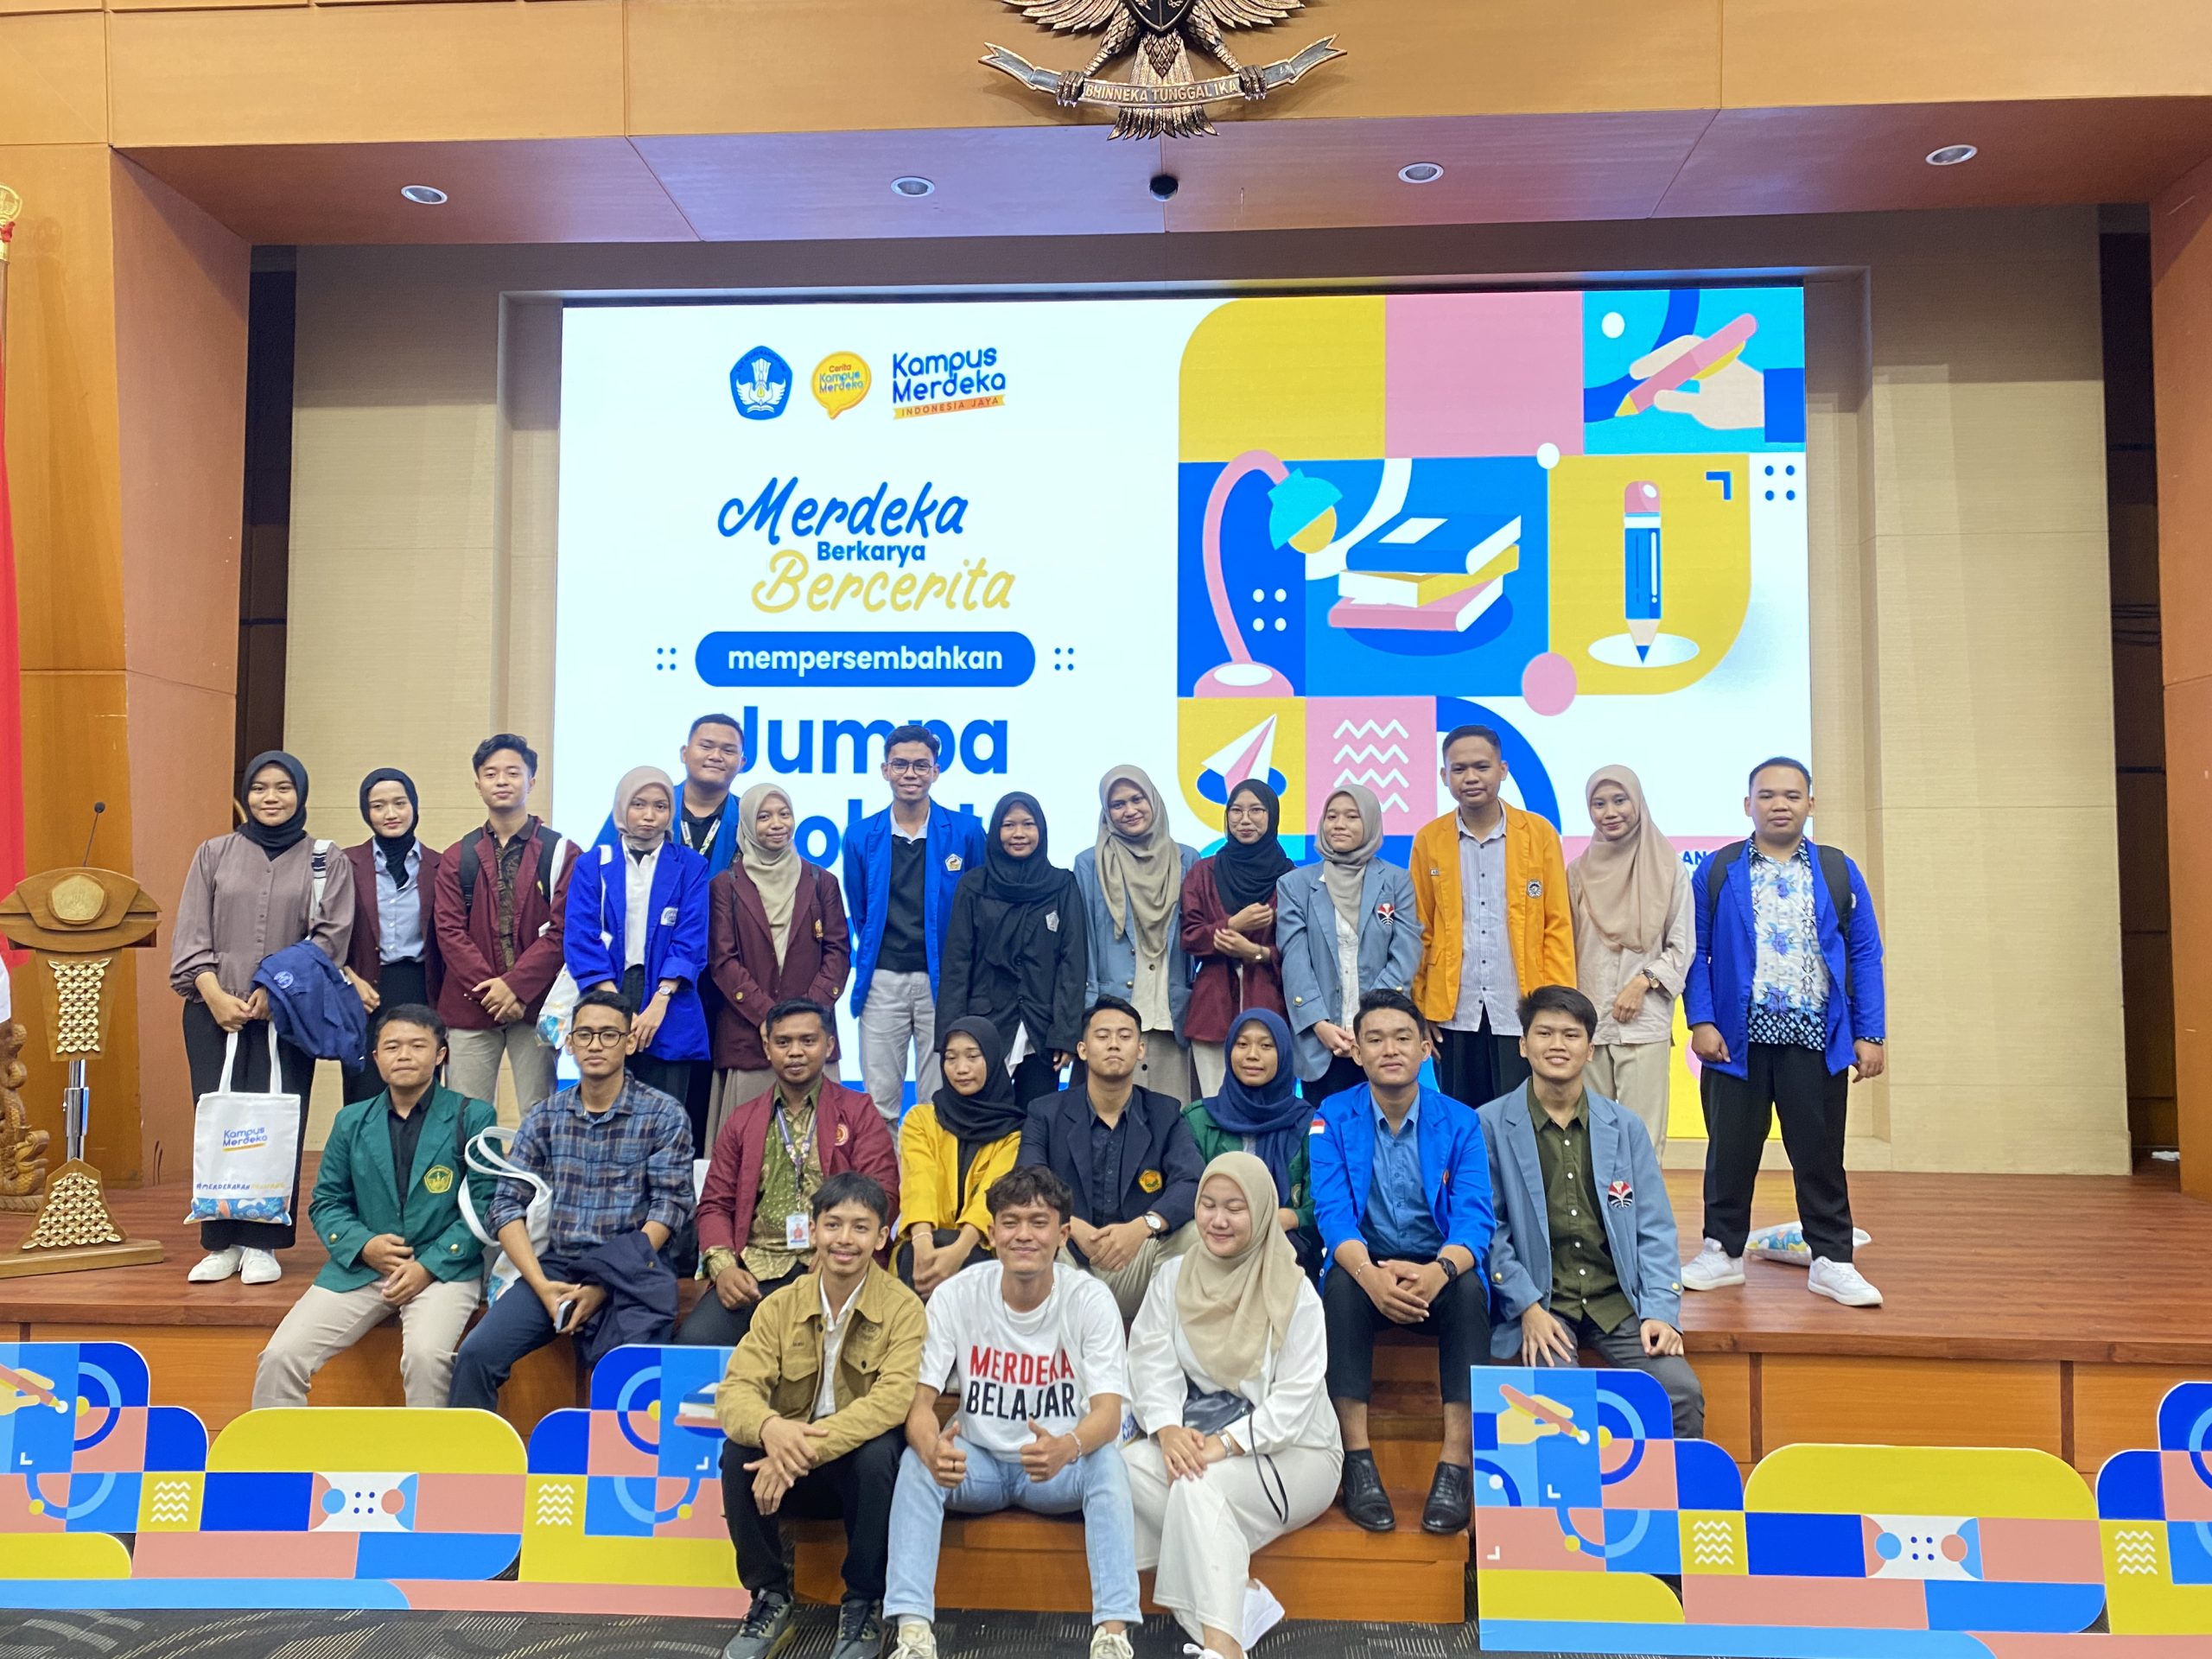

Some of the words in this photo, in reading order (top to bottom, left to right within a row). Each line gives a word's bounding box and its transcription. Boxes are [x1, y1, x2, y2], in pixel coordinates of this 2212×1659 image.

[1084, 84, 1148, 102] BHINNEKA
[1152, 86, 1211, 101] TUNGGAL
[1214, 80, 1239, 95] IKA
[829, 364, 852, 373] Cerita
[893, 347, 997, 378] Kampus
[819, 371, 861, 385] Kampus
[819, 379, 863, 393] Merdeka
[893, 369, 1006, 404] Merdeka
[901, 401, 965, 416] INDONESIA
[971, 397, 999, 410] JAYA
[717, 476, 969, 545] Merdeka
[817, 541, 925, 568] Berkarya
[751, 549, 1016, 613] Bercerita
[728, 645, 1002, 677] mempersembahkan
[223, 1135, 268, 1147] Merdeka
[224, 1127, 265, 1139] Kampus
[969, 1344, 1075, 1387] MERDEKA
[965, 1381, 1077, 1421] BELAJAR
